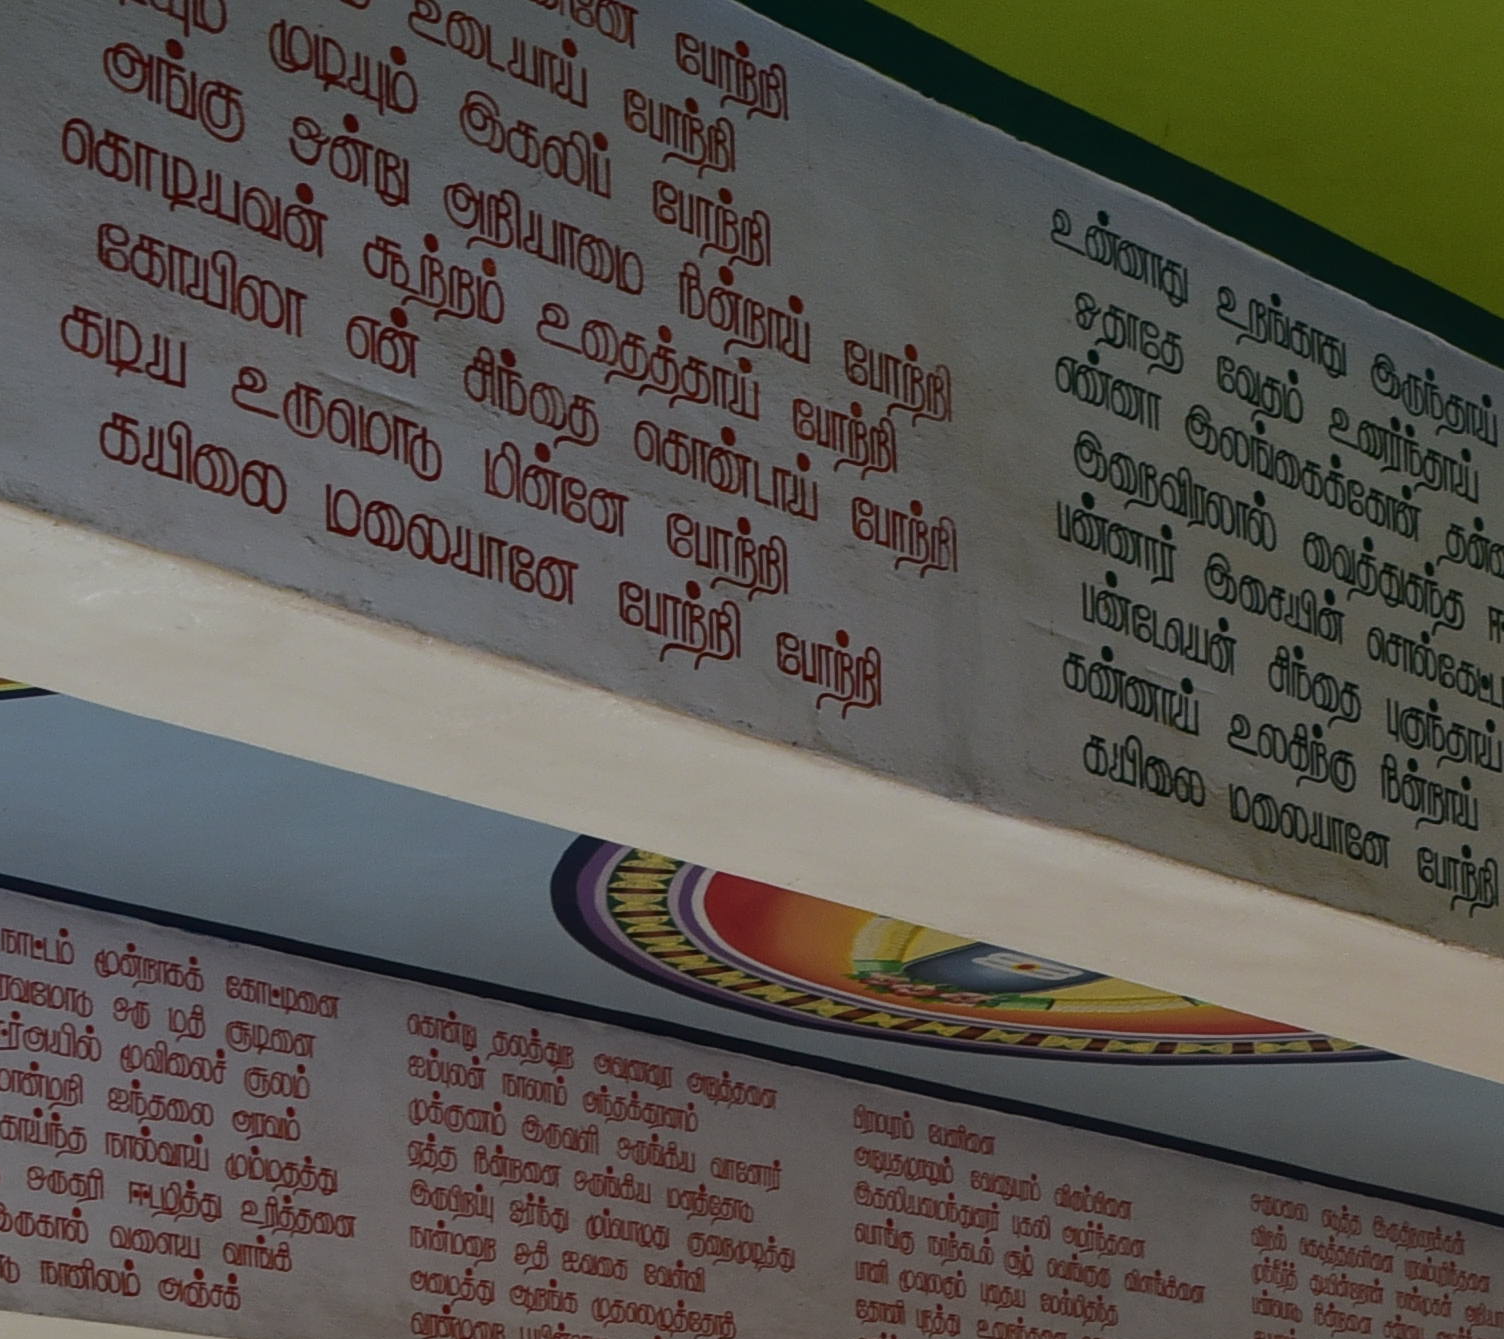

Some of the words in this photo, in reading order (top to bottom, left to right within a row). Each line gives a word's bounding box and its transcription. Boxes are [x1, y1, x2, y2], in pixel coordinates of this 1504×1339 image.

[269, 19, 419, 117] முடியும்
[459, 90, 612, 200] இகலிப்
[652, 179, 771, 287] போற்றி
[409, 7, 588, 109] உடையாய்
[623, 88, 736, 180] போற்றி
[675, 32, 790, 121] போற்றி
[61, 117, 329, 260] கொடியவன்
[362, 233, 505, 325] கூற்றம்
[536, 302, 762, 422] உதைத்தாய்
[792, 398, 898, 481] போற்றி
[103, 38, 246, 144] அங்கு
[288, 112, 410, 208] ஒன்று
[443, 181, 646, 296] அறியாமை
[678, 259, 811, 365] நின்றாய்
[842, 339, 952, 428] போற்றி
[1050, 207, 1189, 309] உண்ணாது
[1215, 285, 1348, 379] உறங்காது
[1370, 352, 1499, 448] இருந்தாய்
[59, 304, 188, 389] கடிய
[231, 365, 443, 482] உருமொடு
[484, 440, 630, 538] மின்னே
[666, 512, 789, 603] போற்றி
[96, 222, 309, 339] கோயிலா
[345, 306, 421, 379] என்
[462, 345, 600, 450] சிந்தை
[633, 419, 821, 522] கொண்டாய்
[851, 496, 958, 579] போற்றி
[99, 411, 288, 515] கயிலை
[325, 483, 580, 606] மலையானே
[618, 579, 742, 671] போற்றி
[775, 629, 882, 720] போற்றி
[1056, 491, 1178, 585] பண்ணார்
[1203, 551, 1346, 646] இசையின்
[1073, 430, 1278, 552] இறைவிரலால்
[1302, 531, 1466, 637] வைத்துகந்த
[1062, 645, 1200, 737] கண்ணாய்
[1227, 713, 1357, 794] உலகிற்கு
[1380, 753, 1479, 832] நின்றாய்
[0, 927, 75, 965] நாட்டம்
[94, 942, 205, 993] மூன்றாகக்
[225, 975, 341, 1019] கோட்டினை
[106, 1078, 214, 1127] ஐந்தலை
[231, 1106, 301, 1142] அரவம்
